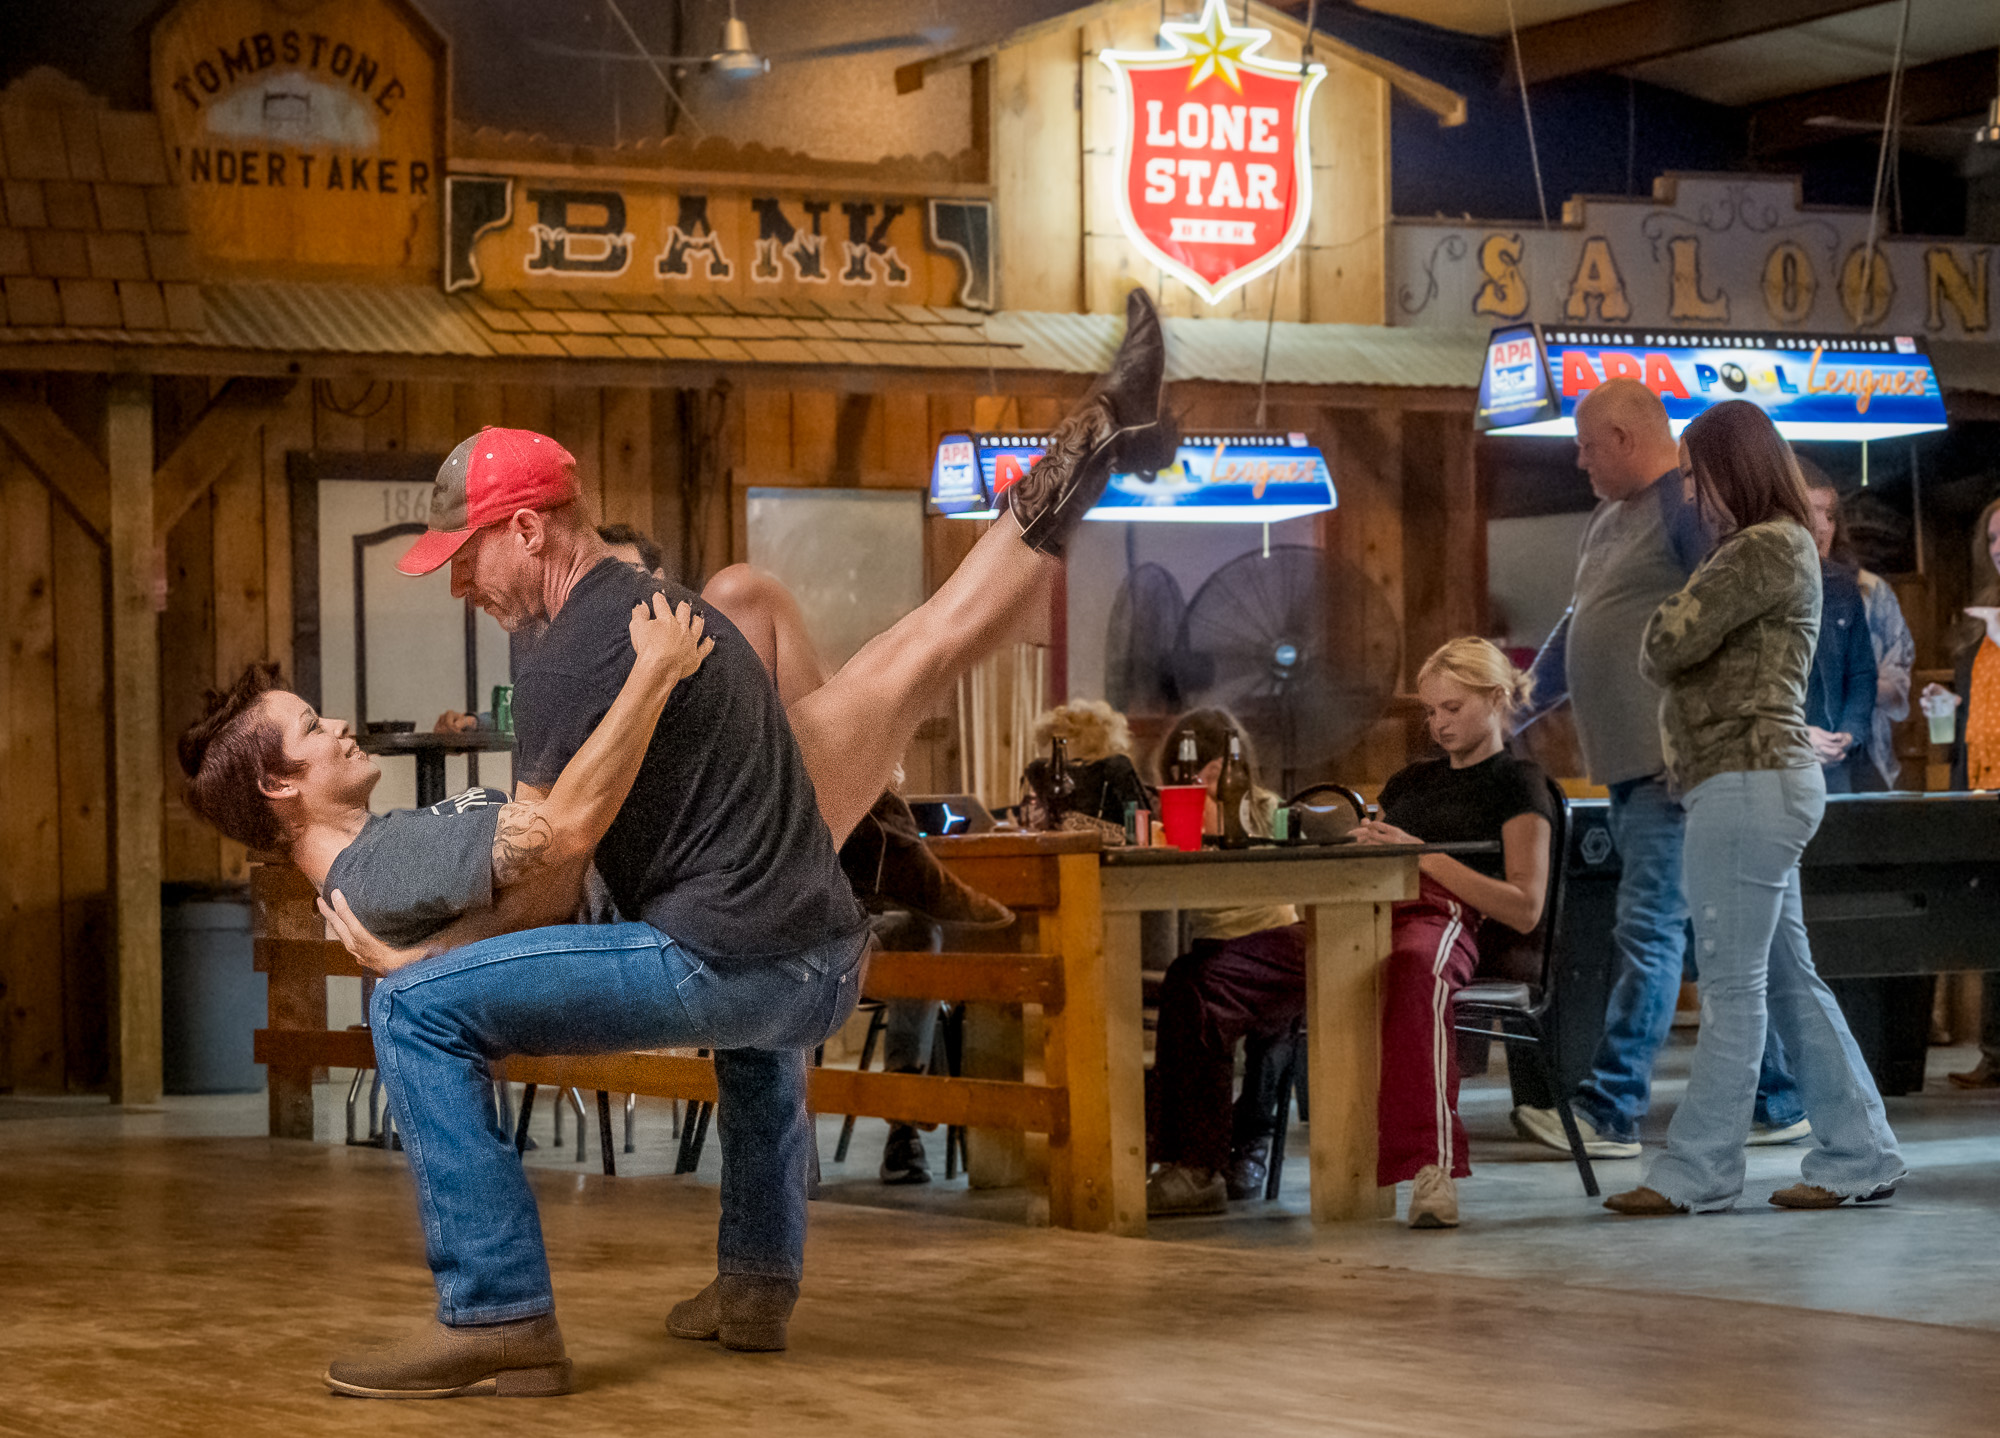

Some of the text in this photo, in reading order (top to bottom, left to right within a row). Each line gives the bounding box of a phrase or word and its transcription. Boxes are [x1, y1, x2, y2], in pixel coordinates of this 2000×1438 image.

[173, 30, 406, 116] TOMBSTONE
[1146, 100, 1279, 153] LONE
[175, 147, 429, 195] NDERTAKER
[1145, 157, 1280, 210] STAR
[524, 189, 911, 286] BANK
[1472, 232, 1991, 334] SALOON
[1494, 340, 1533, 366] APA
[1562, 351, 1692, 399] APA
[1807, 345, 1929, 414] Leagues
[942, 445, 971, 464] APA
[1210, 442, 1317, 499] Leagues
[383, 488, 429, 522] 186
